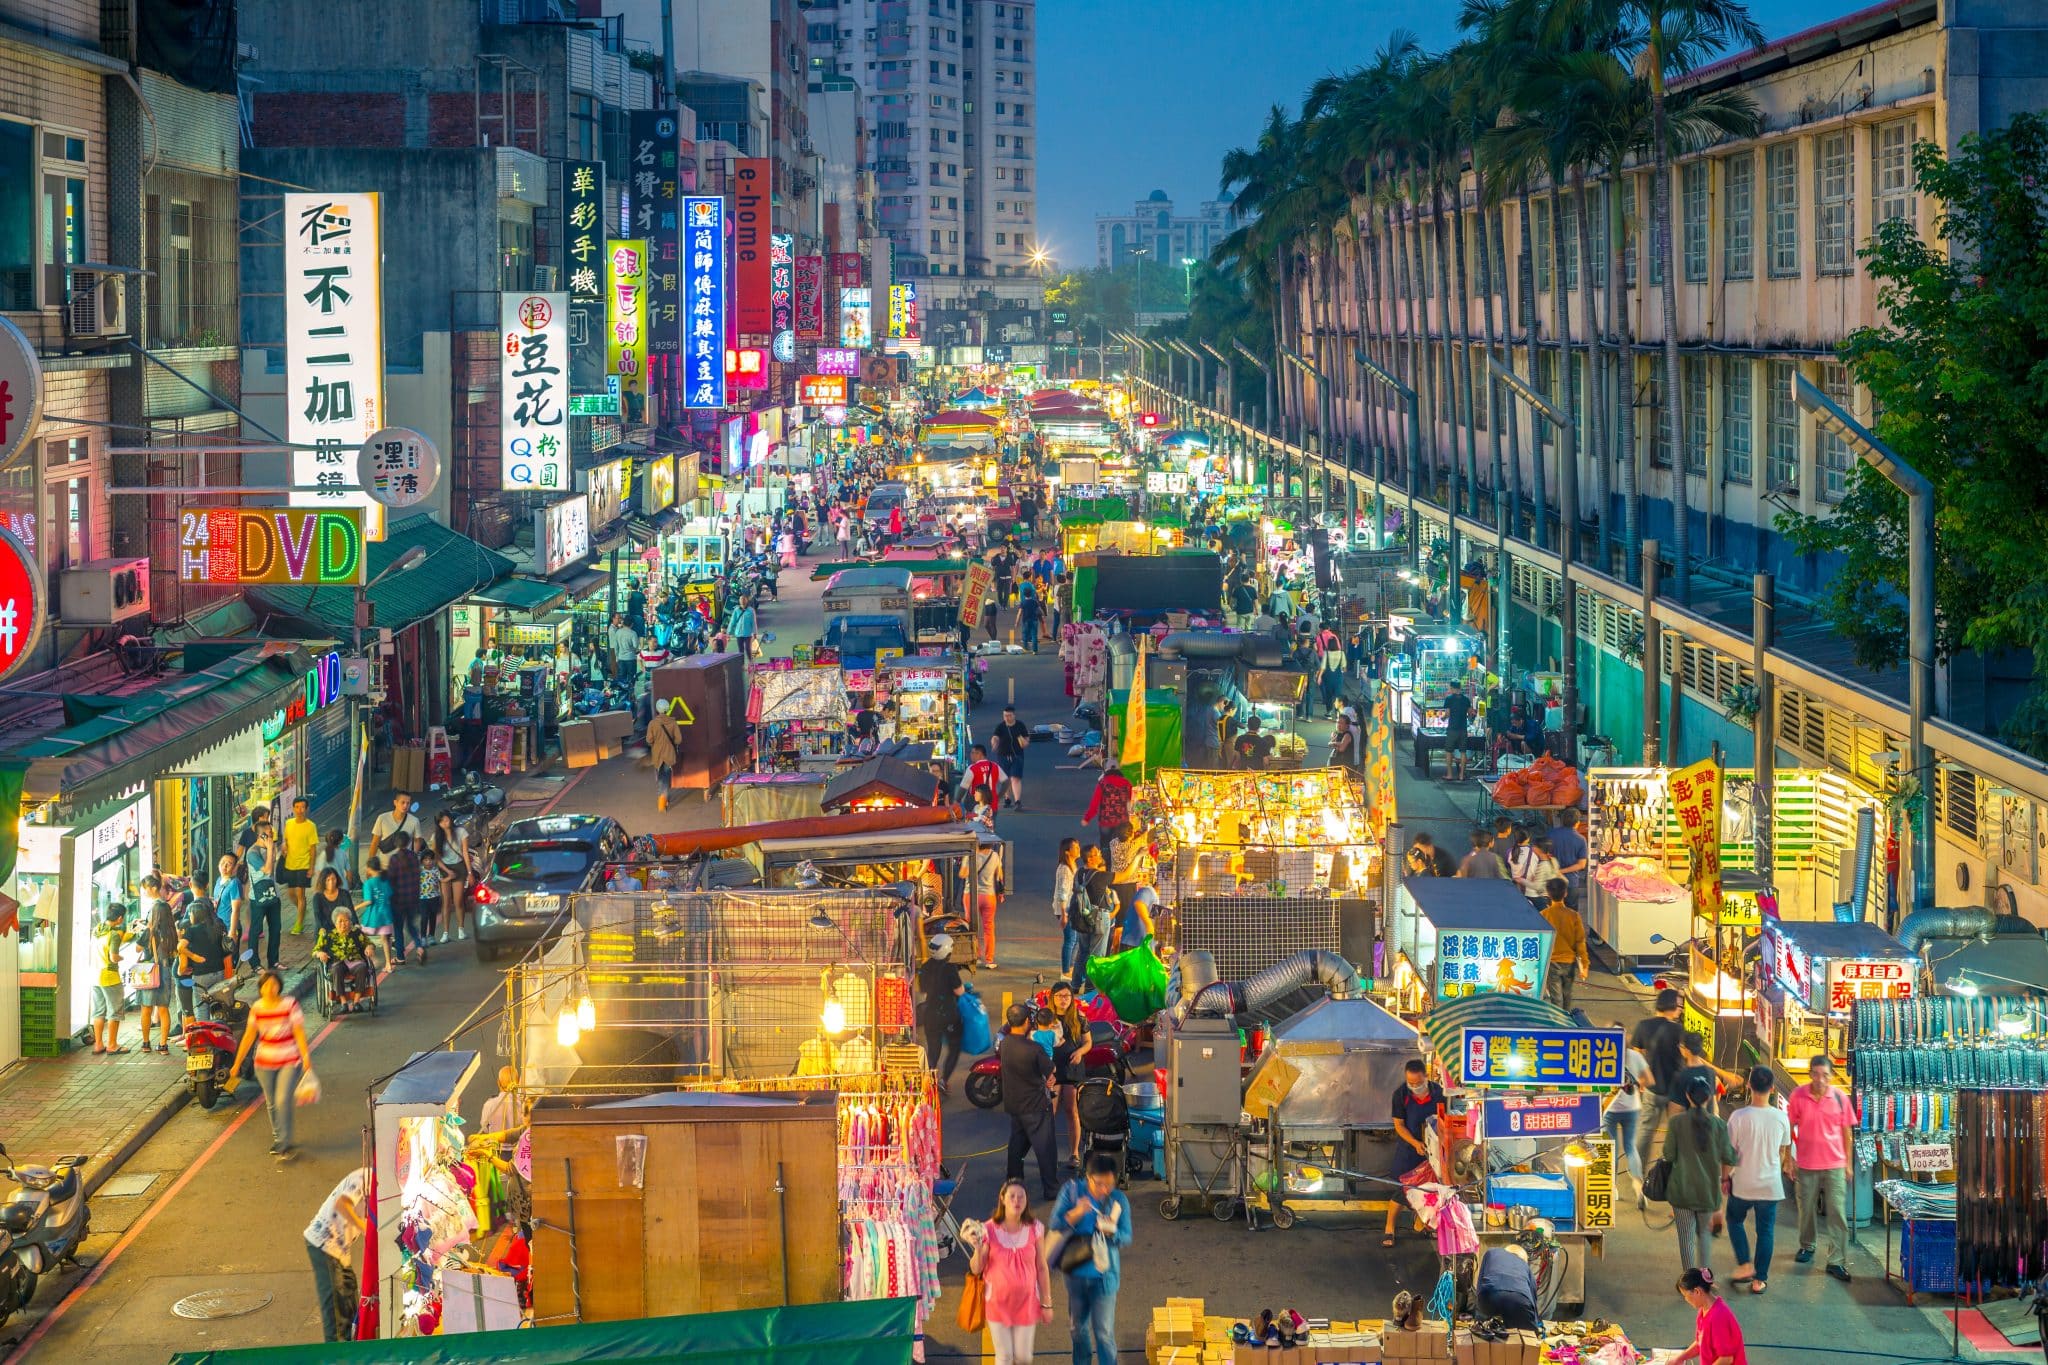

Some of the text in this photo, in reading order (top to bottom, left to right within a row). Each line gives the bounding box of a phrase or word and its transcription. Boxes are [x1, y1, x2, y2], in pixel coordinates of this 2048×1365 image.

[570, 167, 598, 303] 華彩手機
[738, 168, 756, 262] e-home
[613, 248, 642, 375] 銀匠飾品
[650, 341, 678, 350] -9256
[512, 333, 562, 428] 豆花
[536, 433, 561, 488] 粉圓
[182, 513, 209, 545] 24
[238, 513, 359, 580] DVD
[306, 651, 341, 717] DVD
[1443, 934, 1539, 960] 深海魷魚頭
[1443, 961, 1480, 981] 龍珠
[1845, 964, 1899, 979] 屏東自產
[1489, 1036, 1618, 1079] 營養三明治
[1525, 1114, 1572, 1130] 甜甜圈
[1587, 1143, 1612, 1227] 營養三明治
